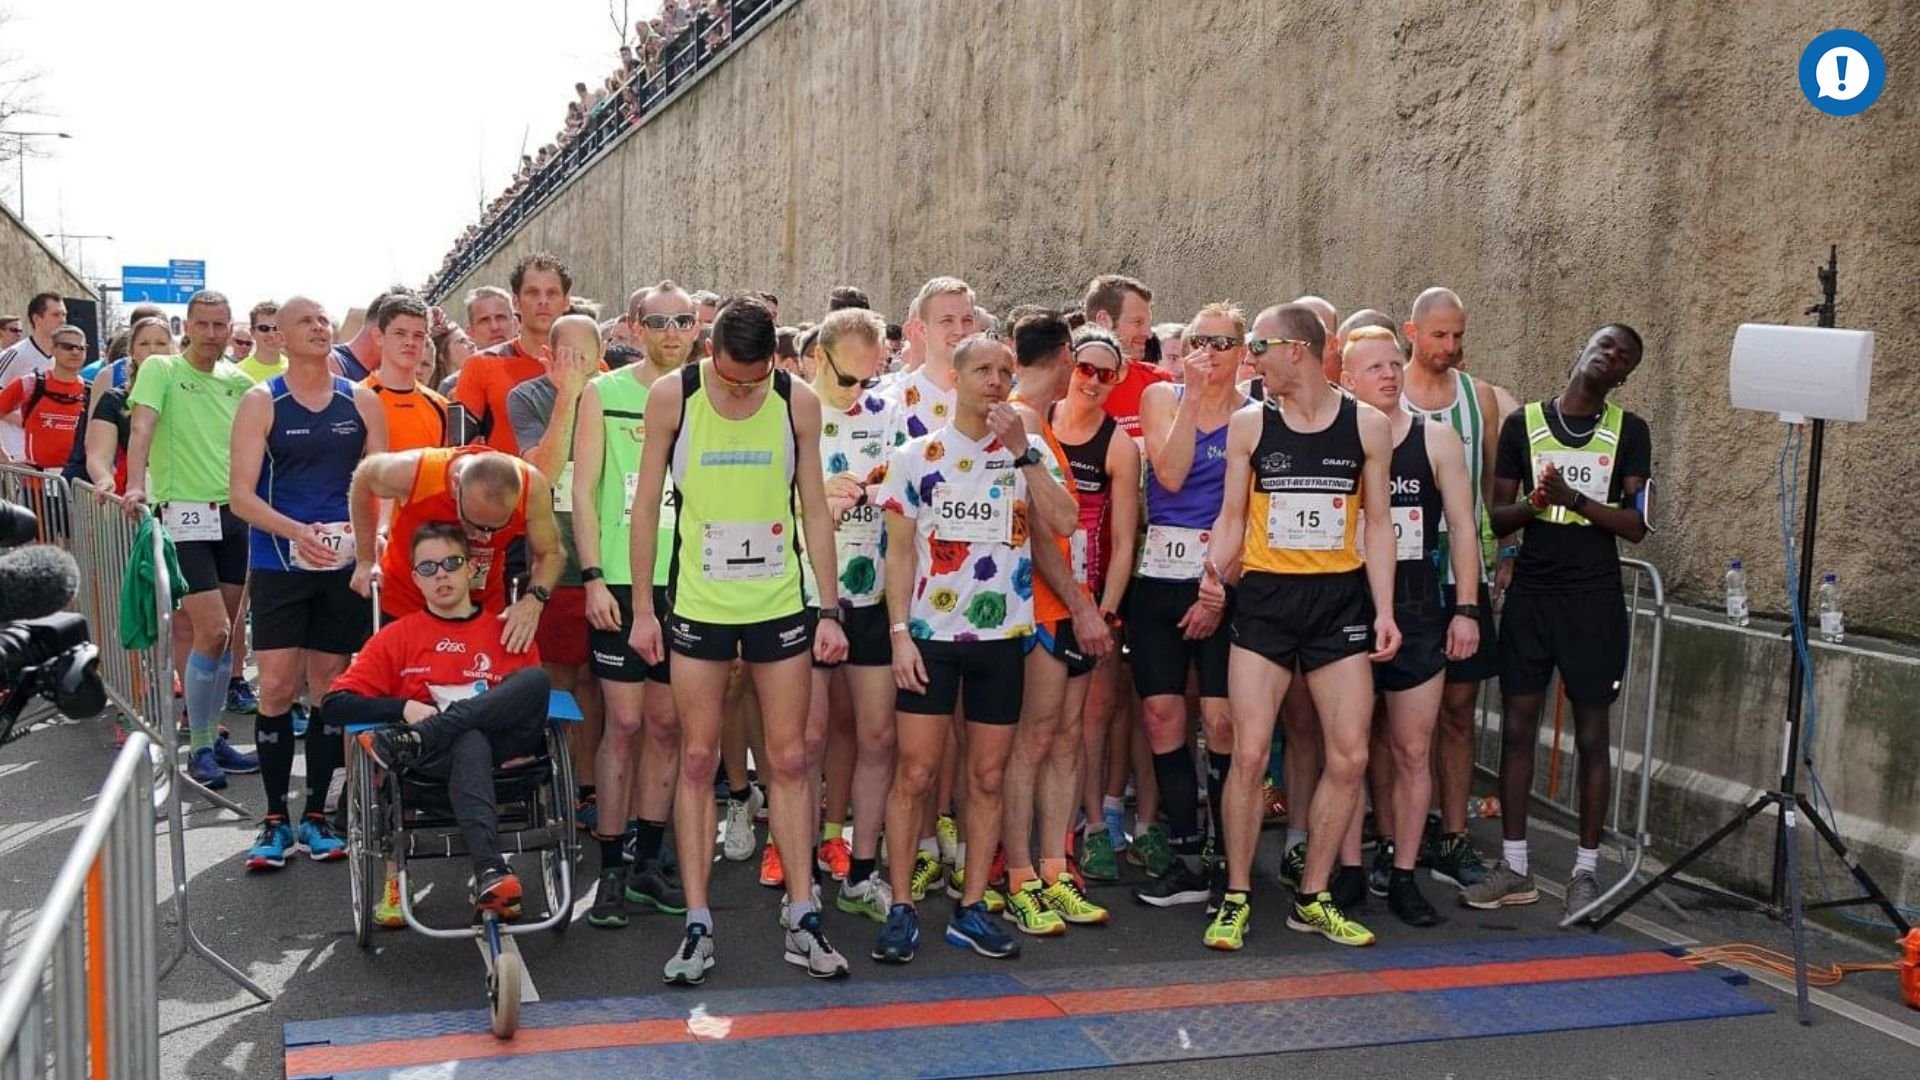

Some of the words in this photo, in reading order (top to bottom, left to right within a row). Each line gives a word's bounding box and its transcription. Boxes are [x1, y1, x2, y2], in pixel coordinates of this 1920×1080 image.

[181, 511, 201, 525] 23
[941, 501, 992, 520] 5649
[1296, 510, 1320, 528] 15
[741, 538, 750, 557] 1
[1165, 541, 1186, 558] 10
